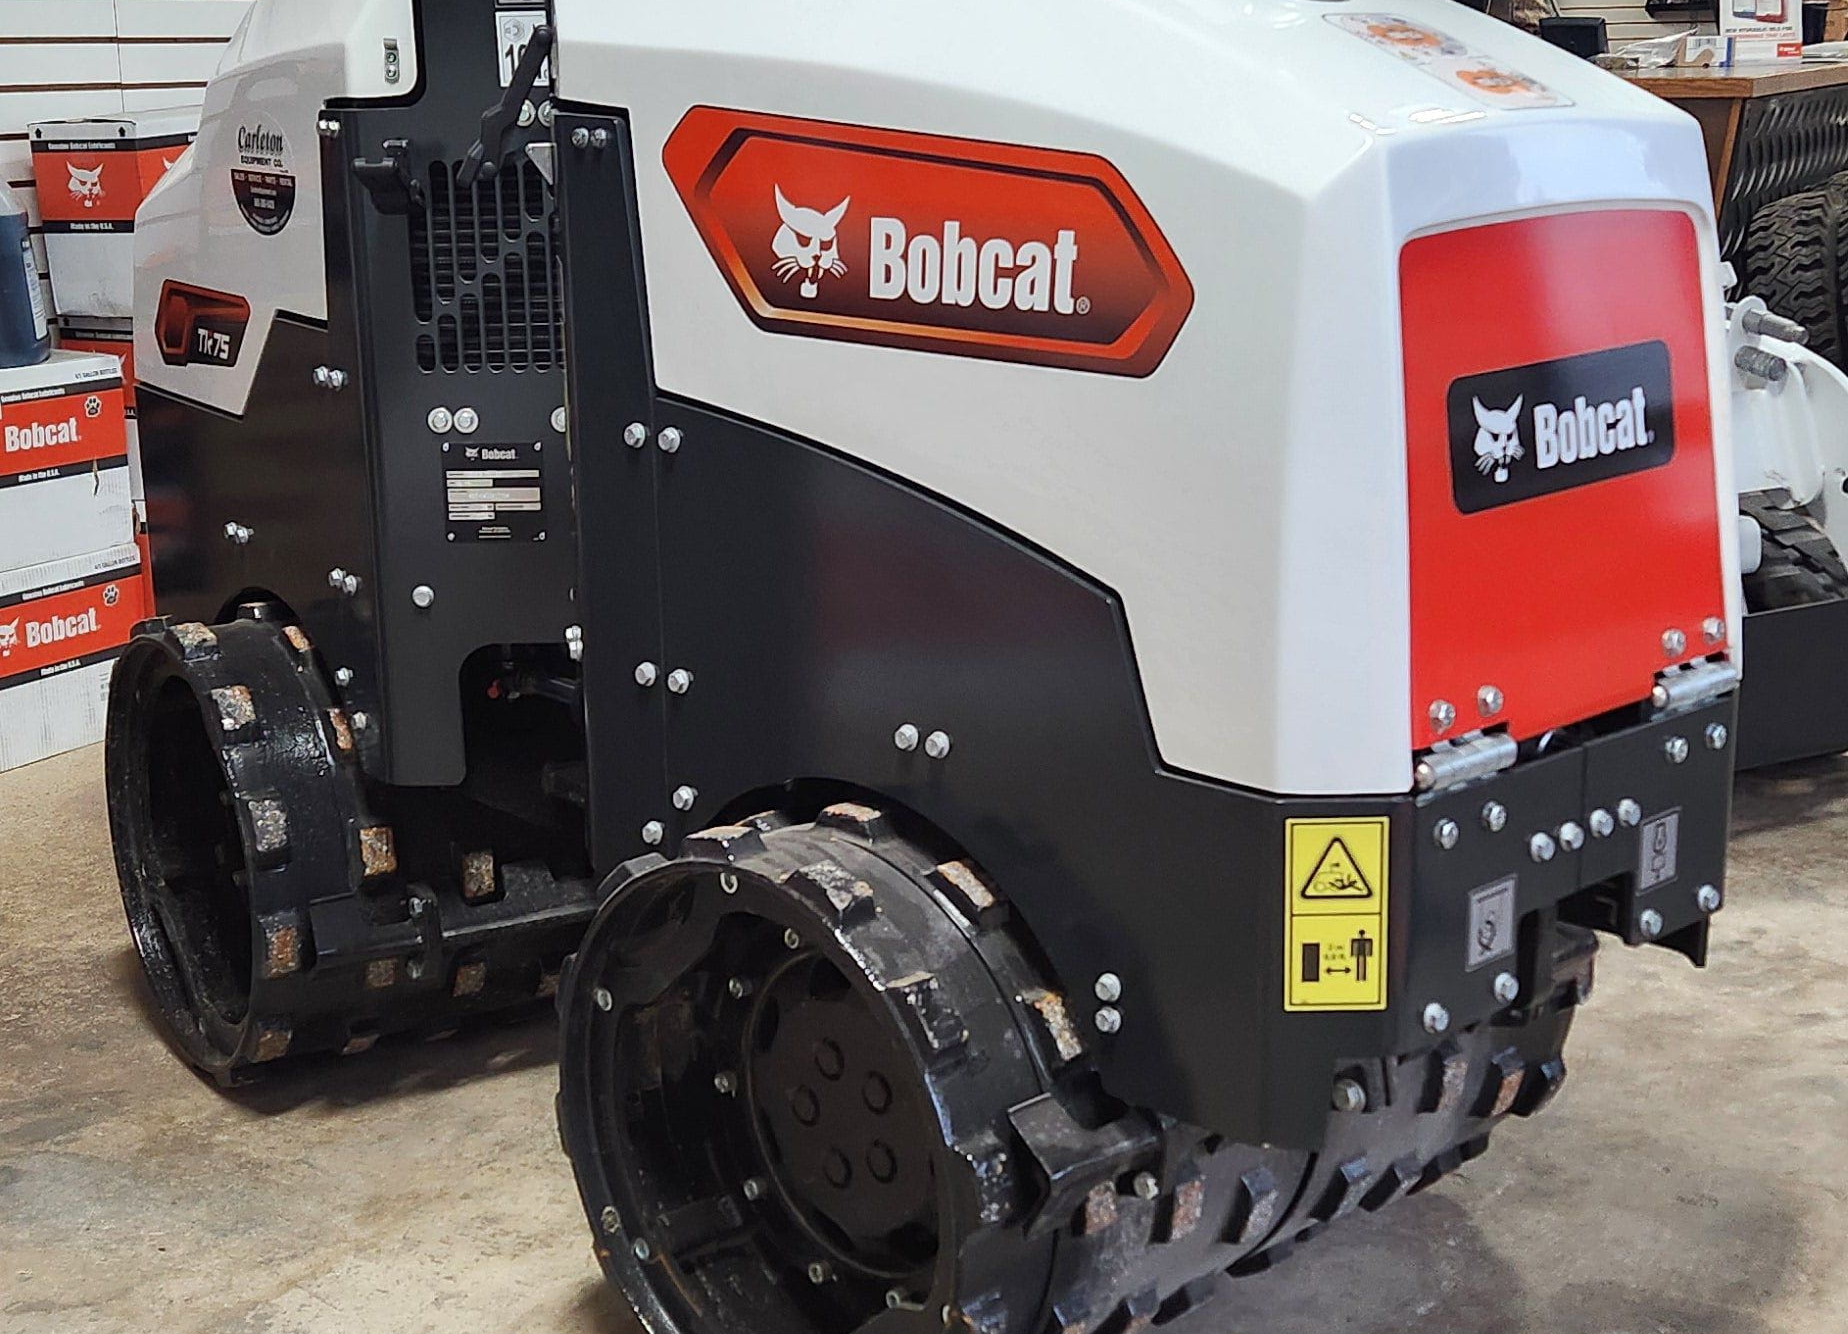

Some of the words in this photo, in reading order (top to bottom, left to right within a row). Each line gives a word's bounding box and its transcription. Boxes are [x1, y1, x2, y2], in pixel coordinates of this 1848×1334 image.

[238, 123, 283, 153] Carleton
[240, 155, 271, 166] EQUIPMENT
[868, 216, 1080, 315] Bobcat
[5, 417, 79, 453] Bobcat
[1532, 386, 1651, 470] Bobcat
[481, 448, 516, 460] Bobcat
[25, 607, 98, 648] Bobcat
